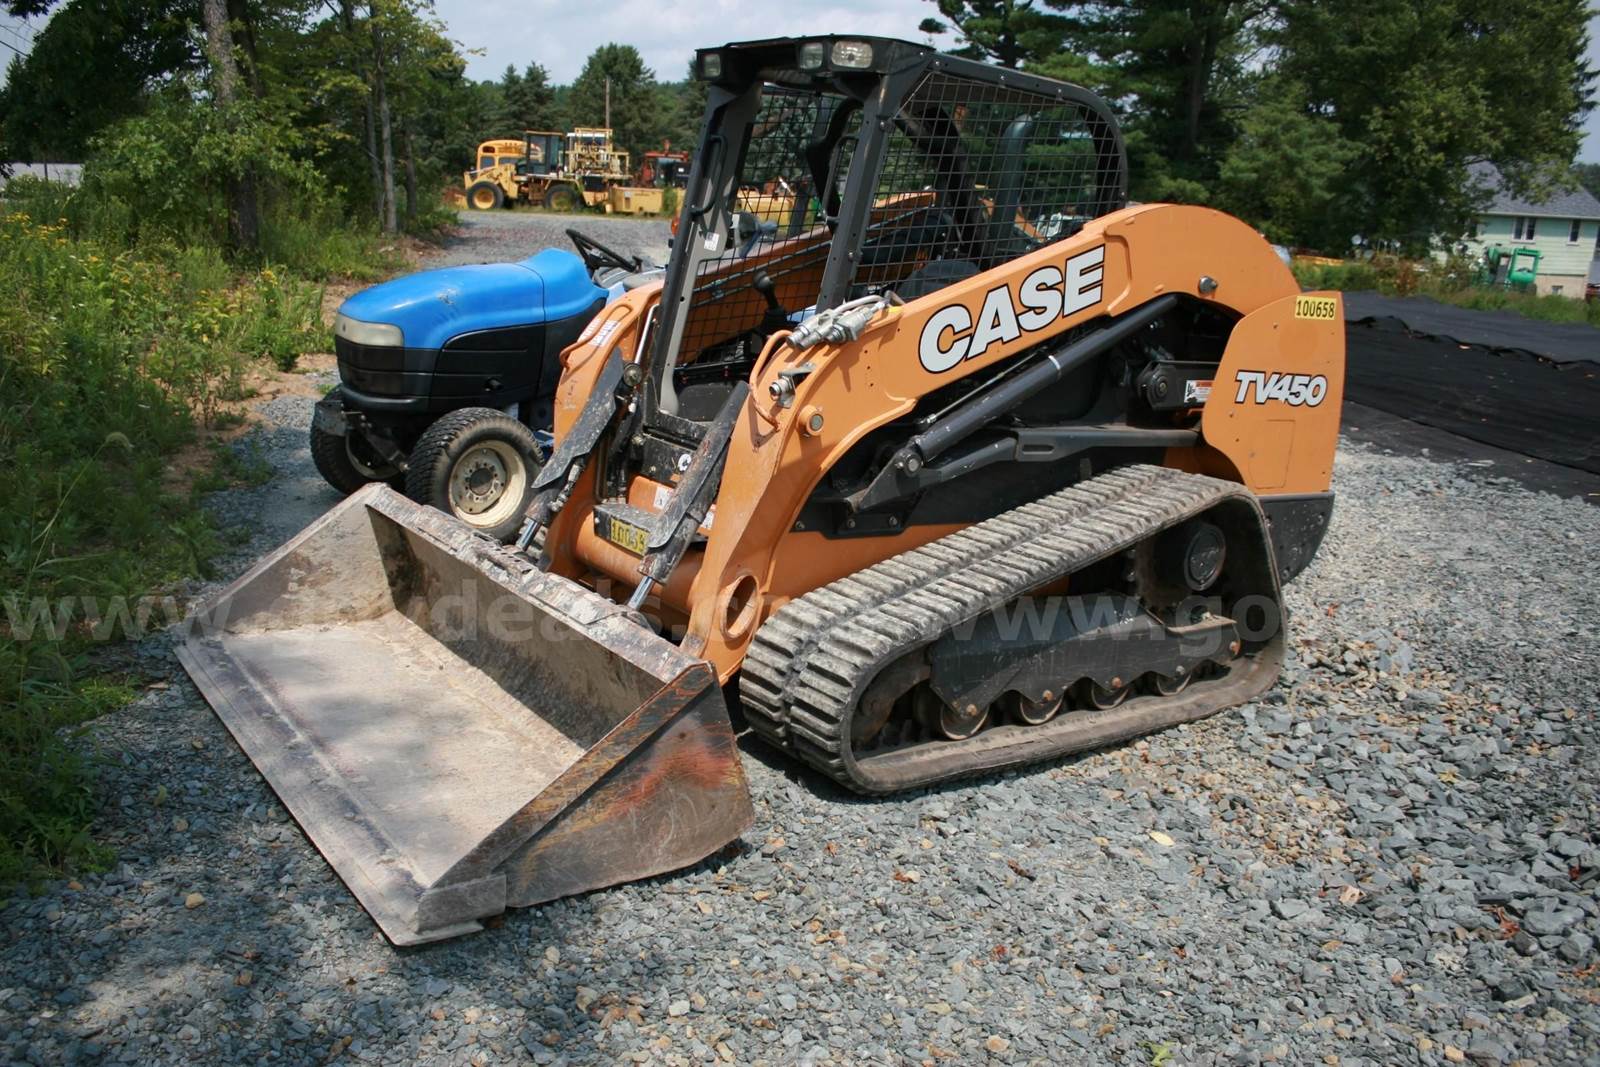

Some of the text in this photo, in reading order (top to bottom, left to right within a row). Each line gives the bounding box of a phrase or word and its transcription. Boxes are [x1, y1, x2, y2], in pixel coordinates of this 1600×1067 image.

[918, 243, 1105, 374] CASE
[1296, 299, 1336, 319] 100658
[1234, 369, 1328, 408] TV450
